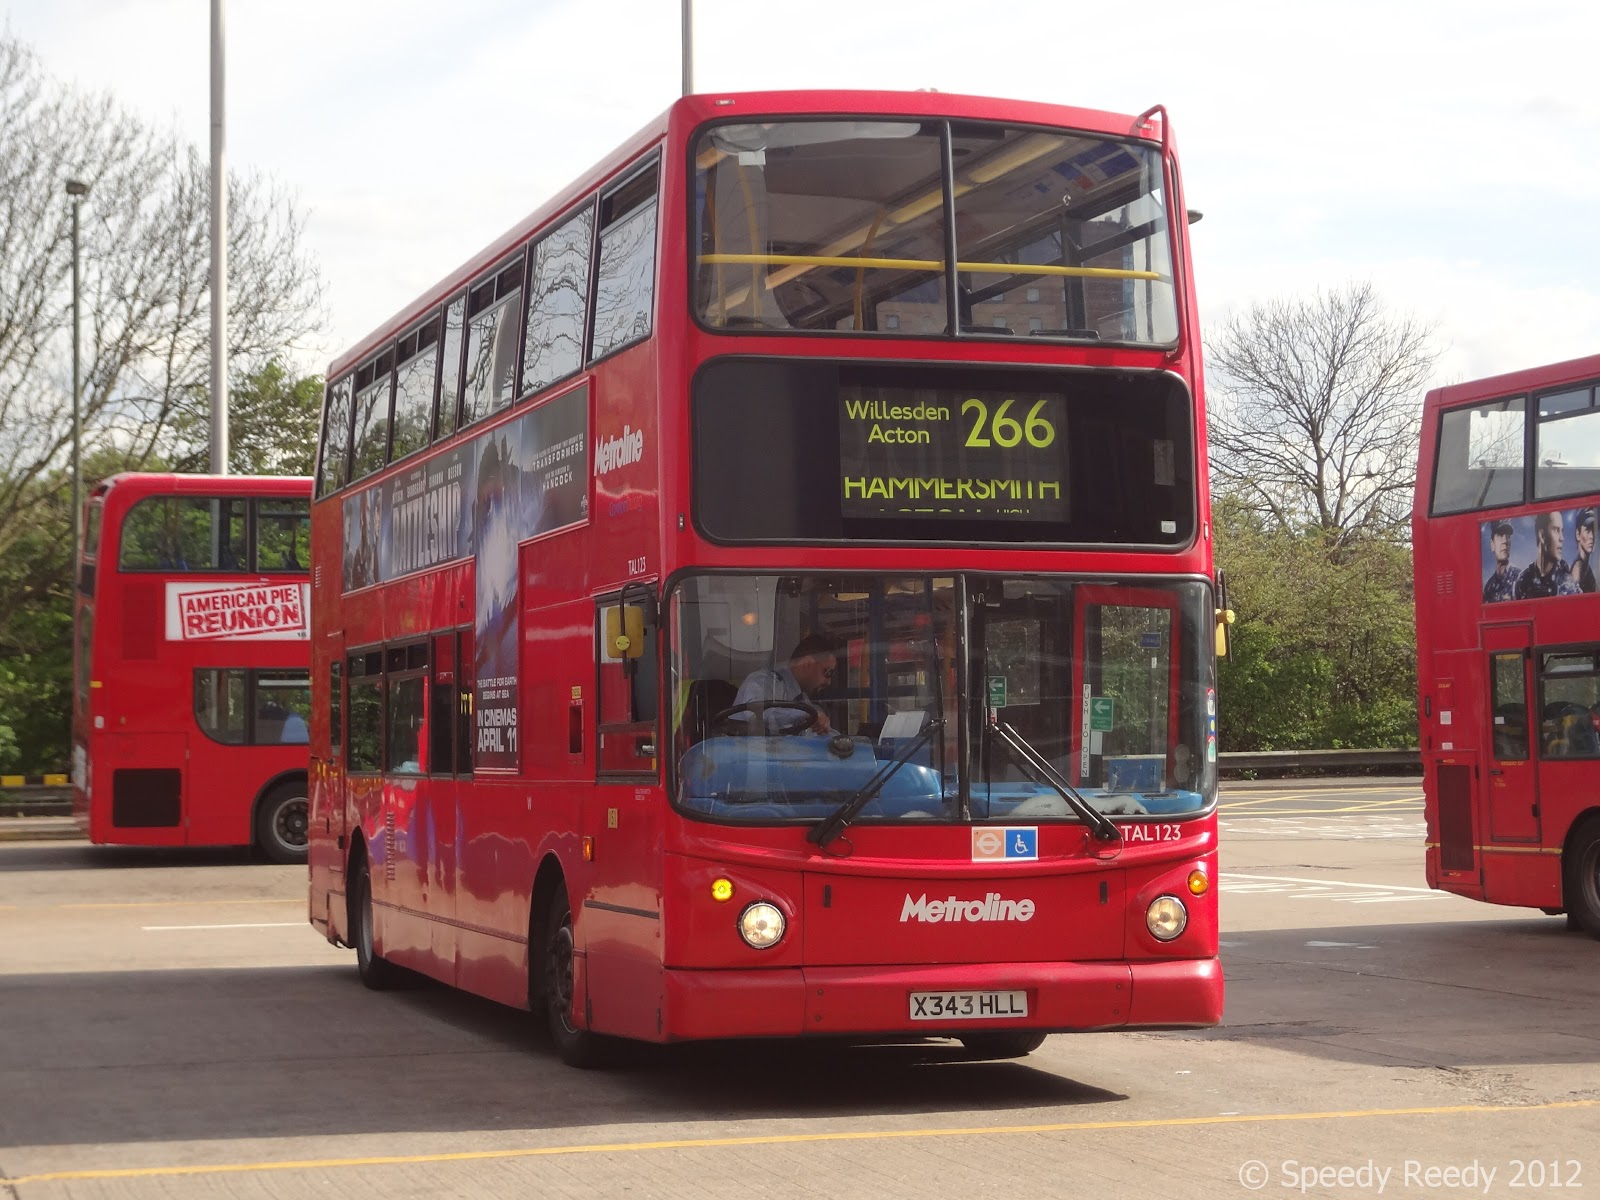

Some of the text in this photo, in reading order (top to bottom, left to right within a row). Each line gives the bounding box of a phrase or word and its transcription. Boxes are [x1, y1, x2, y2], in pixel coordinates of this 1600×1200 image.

[845, 400, 950, 421] Willesden
[868, 423, 930, 444] Acton
[961, 398, 1056, 448] 266
[533, 440, 584, 472] TRANSFORMERS
[594, 424, 643, 477] Metroline
[542, 470, 573, 492] HANCOCK
[845, 476, 1060, 500] HAMMERSMITH
[628, 556, 647, 576] TAL123
[186, 587, 298, 614] AMERICAN PIE:
[186, 603, 299, 635] REUNION
[483, 678, 496, 688] BATTLE
[497, 677, 505, 687] FOR
[505, 676, 517, 686] EARTH
[501, 689, 510, 699] SEA
[477, 707, 517, 727] IN CINEMAS
[477, 727, 517, 752] APRIL 11
[1082, 724, 1089, 738] TO
[1081, 747, 1089, 776] OPEN
[1121, 824, 1182, 842] TAL123
[900, 892, 1035, 923] Metroline
[914, 993, 1024, 1017] X343 HLL
